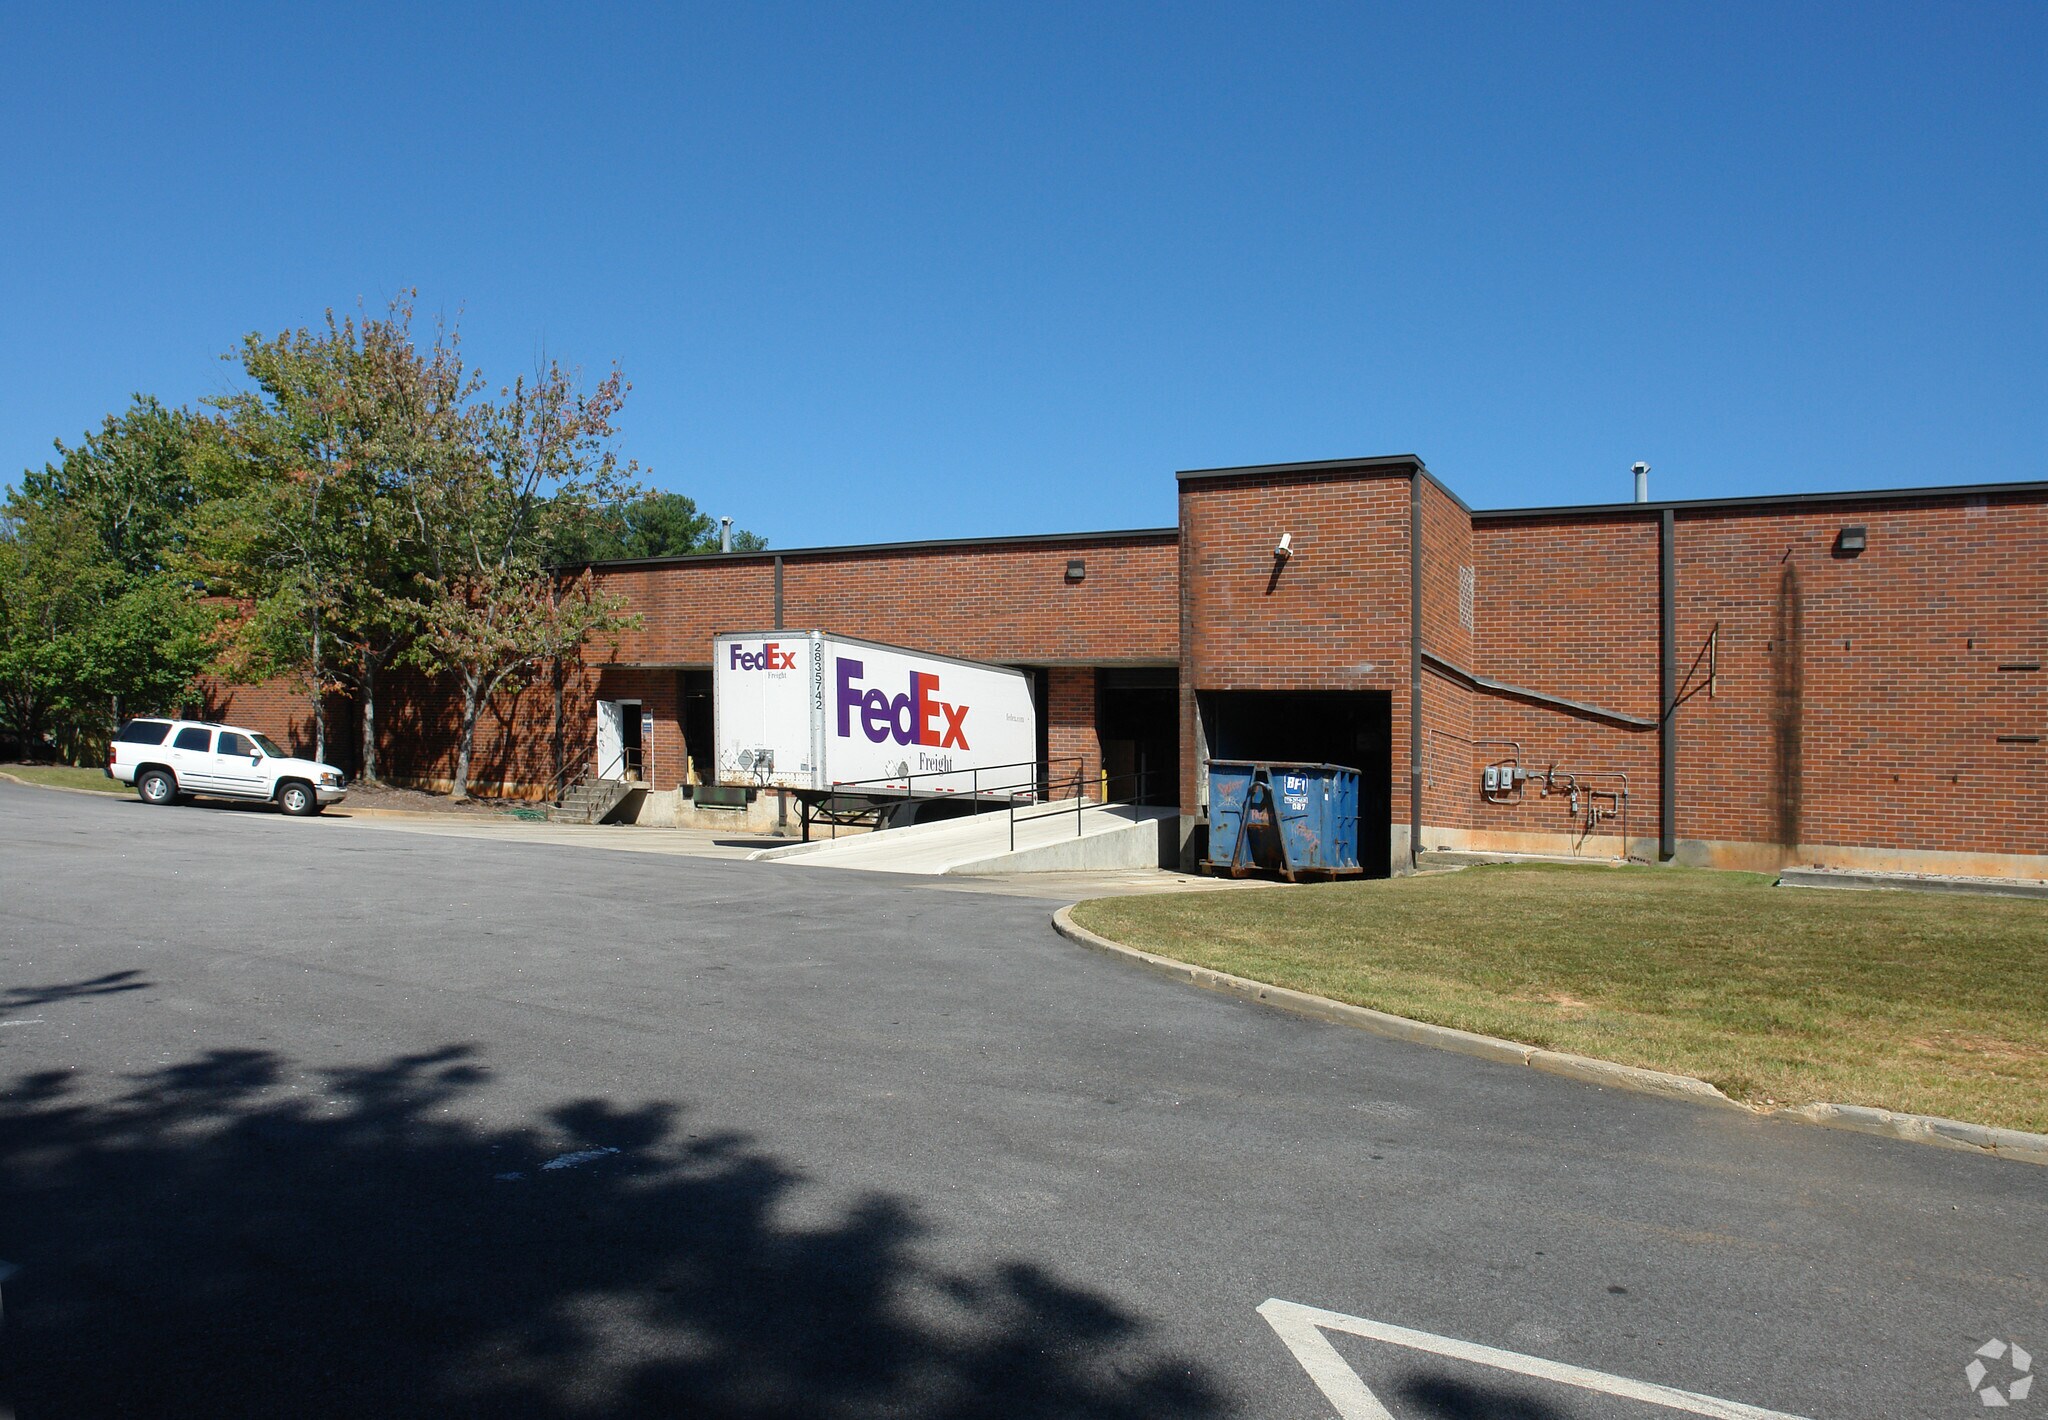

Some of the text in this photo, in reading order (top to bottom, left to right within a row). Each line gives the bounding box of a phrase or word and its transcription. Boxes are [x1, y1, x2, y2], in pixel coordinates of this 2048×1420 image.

[730, 643, 797, 671] FedEx
[767, 671, 787, 680] Freight
[814, 642, 823, 710] 2835742
[836, 657, 970, 750] FedEx
[919, 752, 953, 777] Freight
[1287, 776, 1306, 792] BFI
